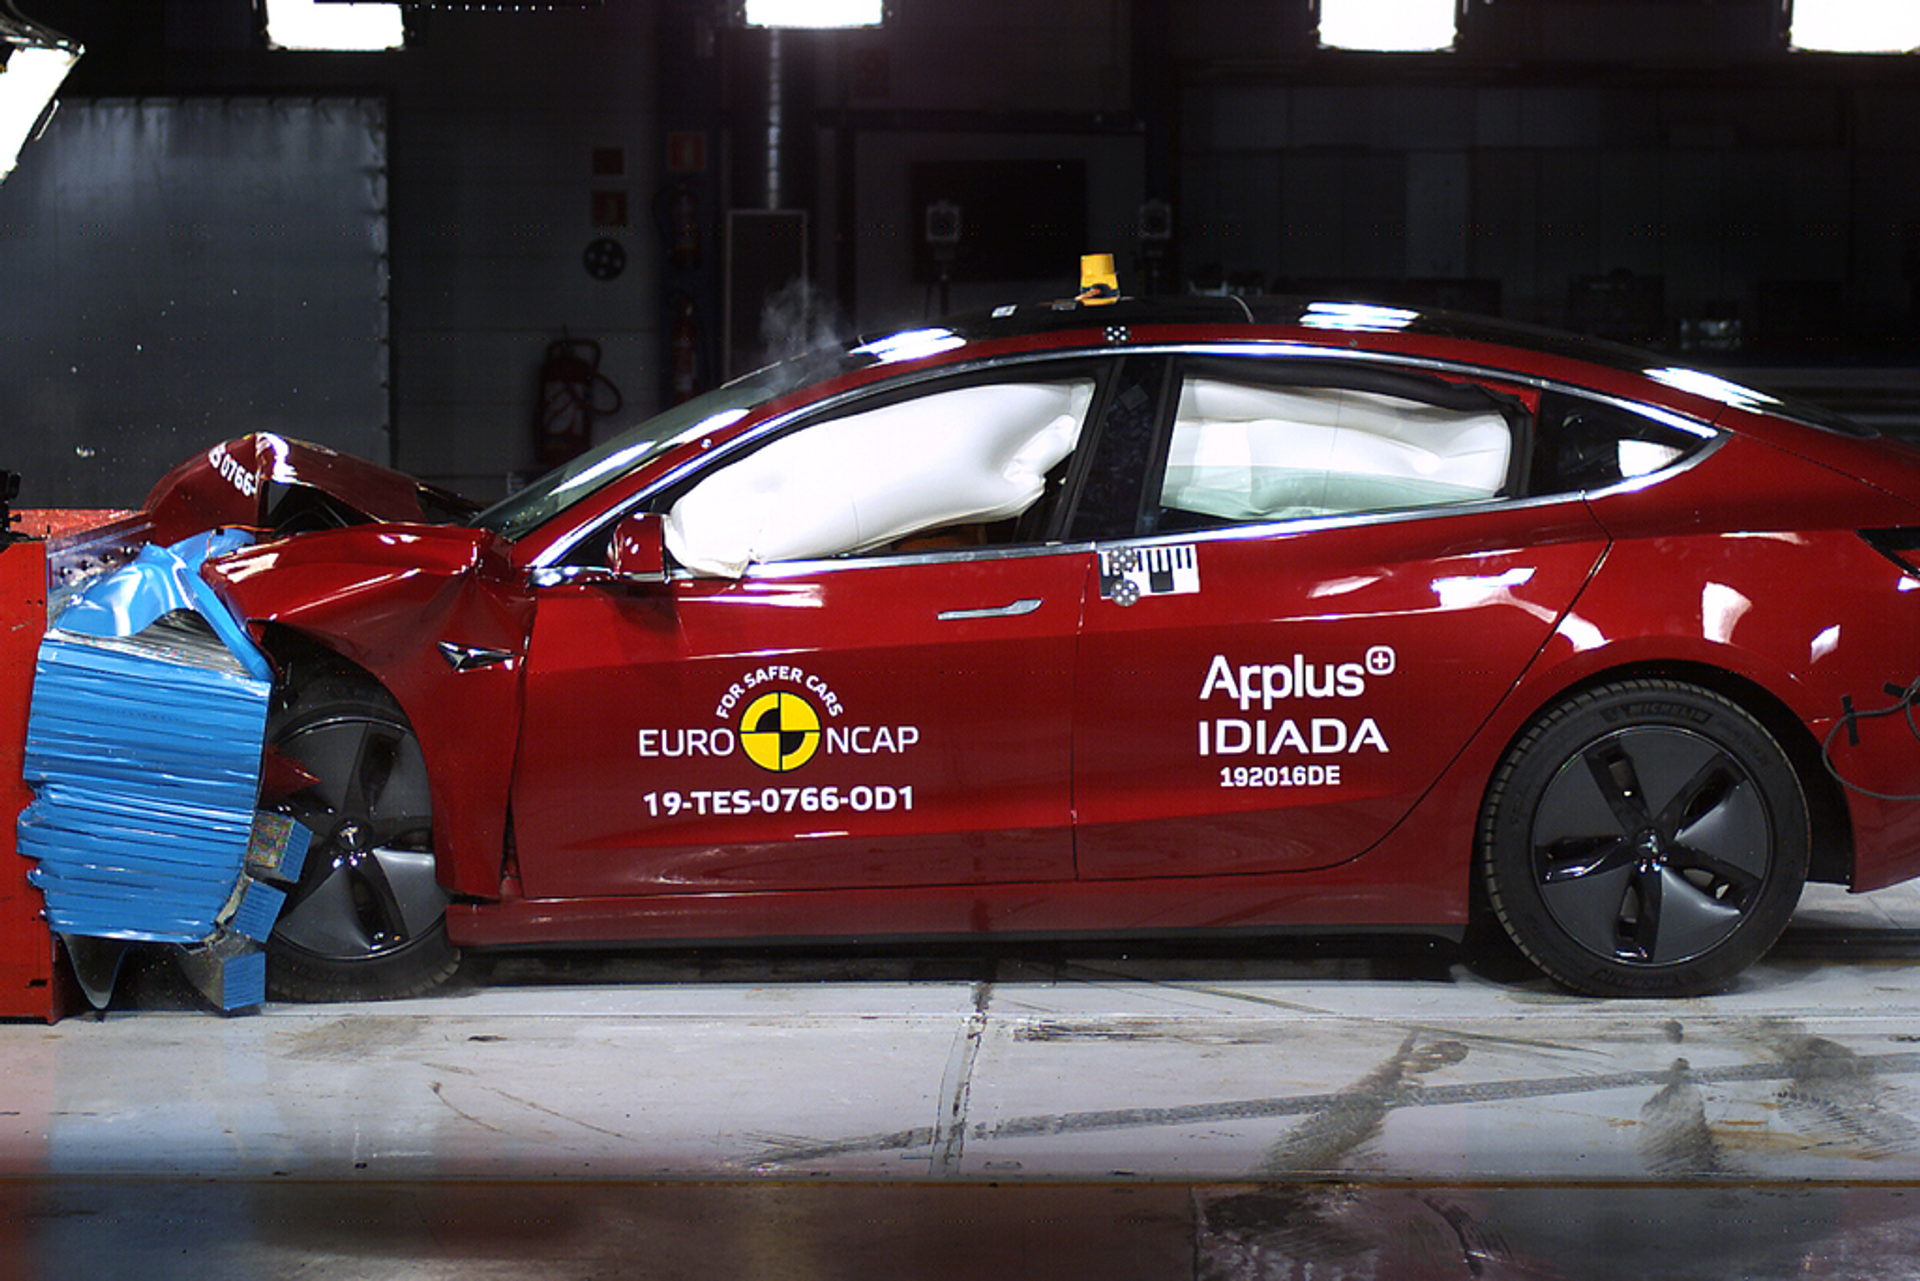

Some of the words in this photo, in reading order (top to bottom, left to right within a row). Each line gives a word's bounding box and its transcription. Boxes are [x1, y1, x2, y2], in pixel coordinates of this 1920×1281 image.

[715, 683, 746, 719] FOR
[743, 665, 804, 689] SAFER
[805, 675, 844, 717] CARS
[1627, 702, 1707, 723] MICHELIN
[638, 728, 735, 757] EURO
[826, 726, 920, 754] NCAP
[1199, 718, 1390, 756] IDIADA
[1220, 765, 1341, 787] 192016DE
[643, 785, 913, 817] 19-TES-0766-OD1
